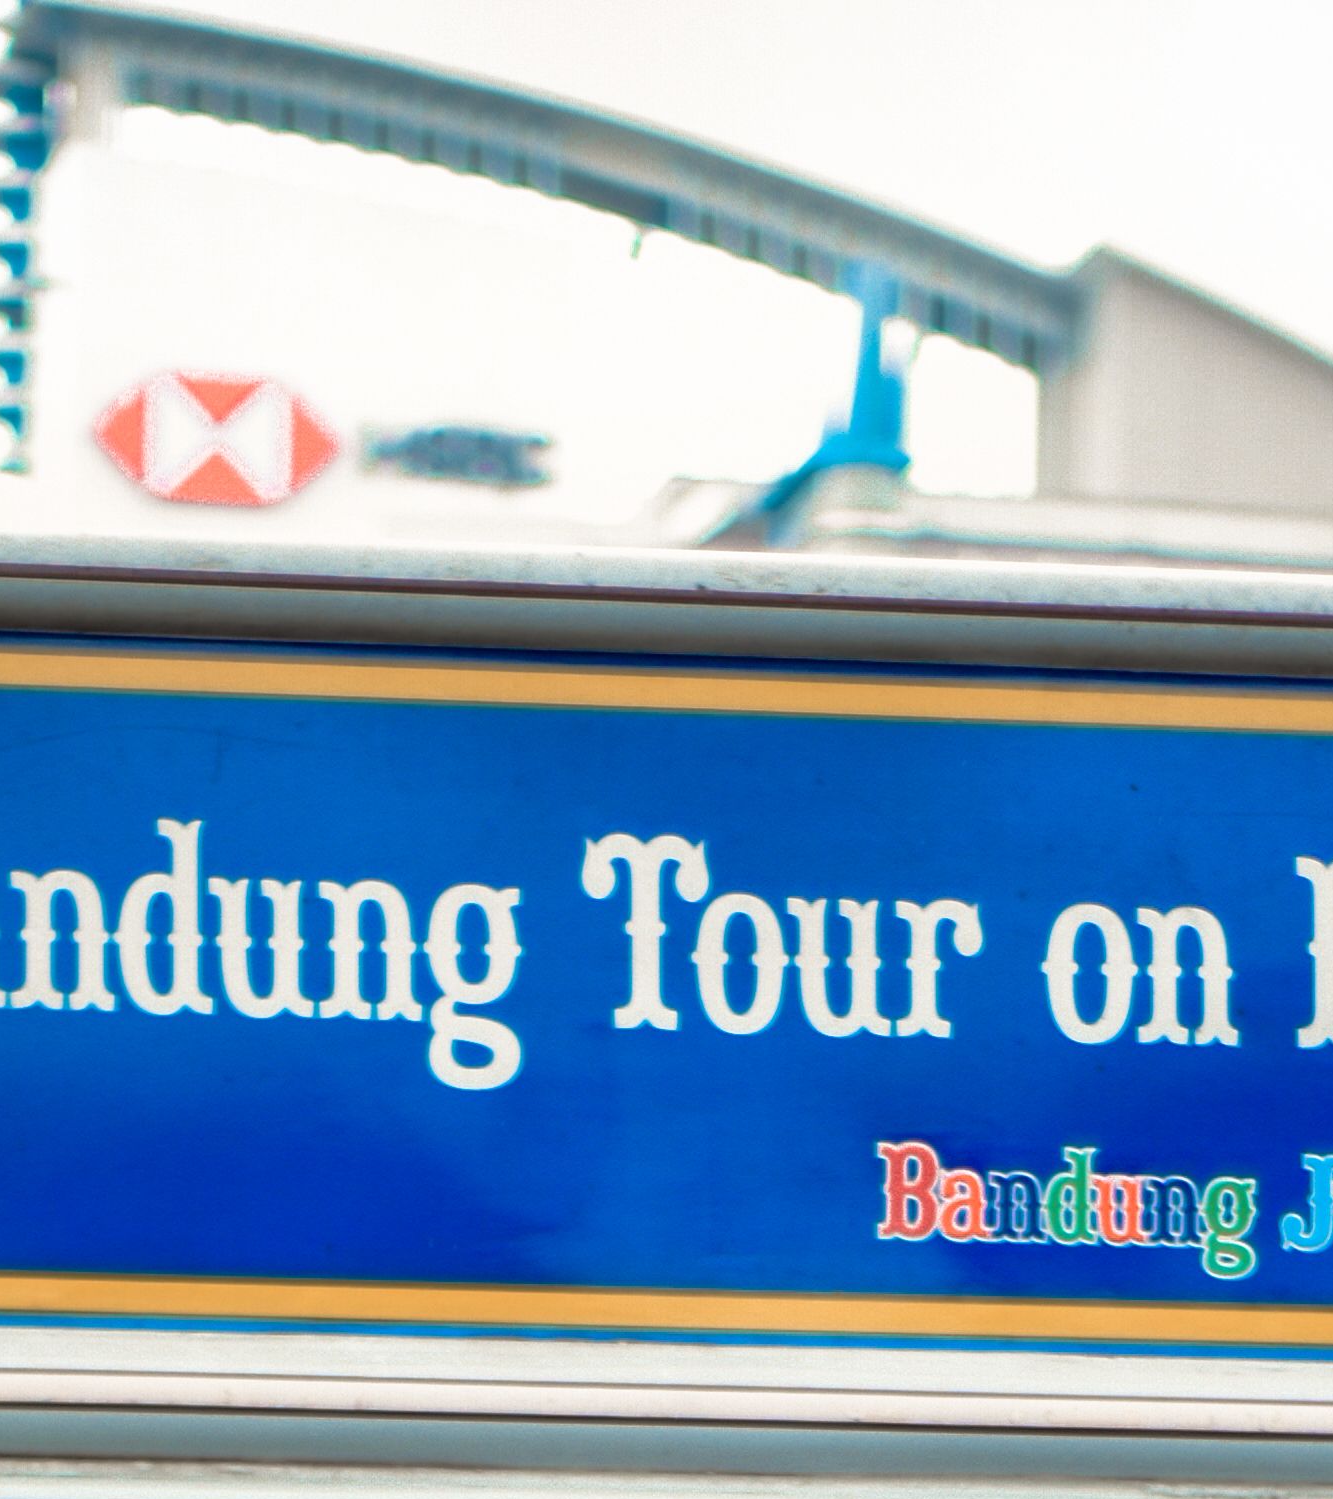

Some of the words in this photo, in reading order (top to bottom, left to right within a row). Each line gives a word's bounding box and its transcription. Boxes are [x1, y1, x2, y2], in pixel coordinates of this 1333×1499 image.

[580, 832, 985, 1039] Tour
[1041, 902, 1240, 1048] on
[875, 1141, 1258, 1281] Bandung
